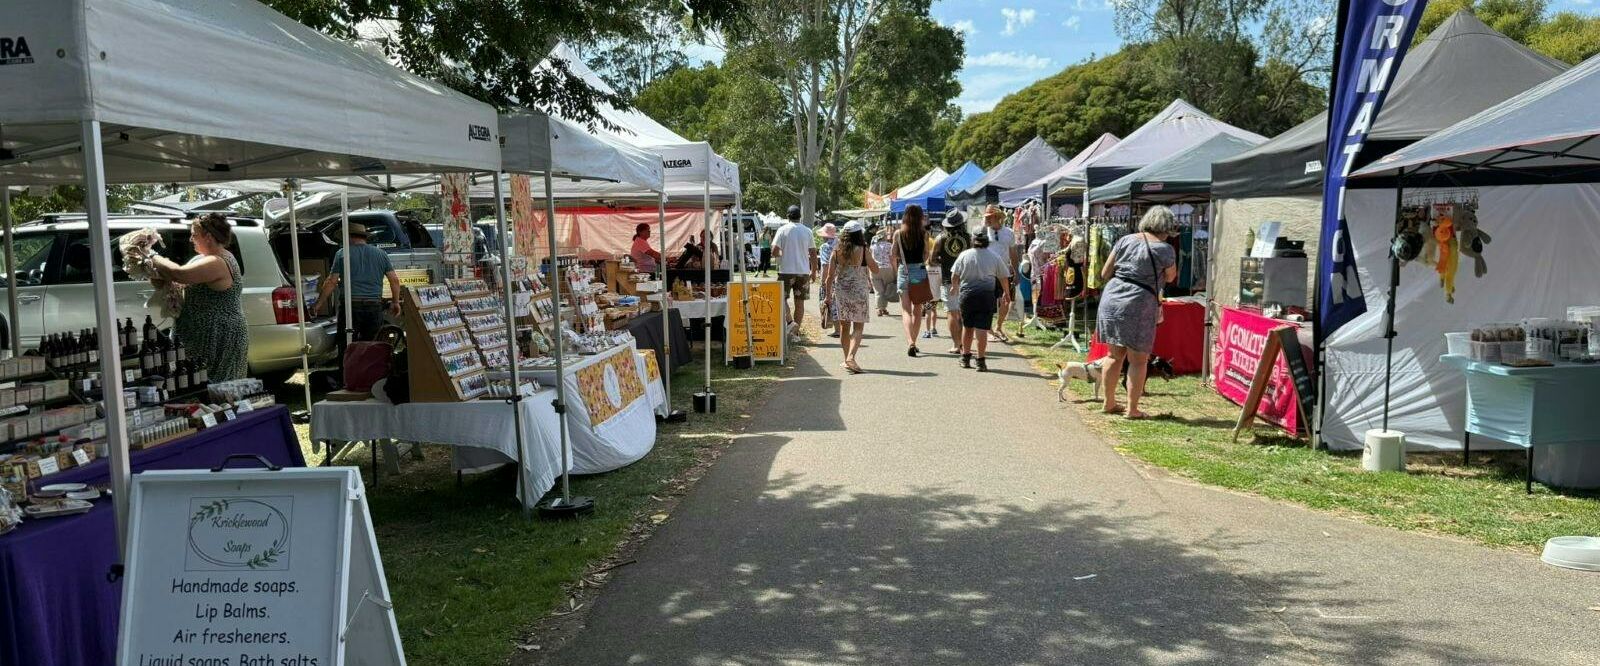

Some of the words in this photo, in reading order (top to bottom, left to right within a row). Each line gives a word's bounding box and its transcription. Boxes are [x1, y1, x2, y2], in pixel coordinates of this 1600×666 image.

[738, 301, 773, 314] HVES
[1230, 324, 1268, 355] GOMATH
[211, 512, 272, 529] Kricklewood
[223, 539, 252, 559] Soaps
[171, 578, 249, 593] Handmade
[253, 580, 300, 597] soaps.
[195, 603, 218, 623] Lip
[223, 603, 271, 618] Balms.
[173, 629, 197, 644] Air
[202, 628, 291, 644] fresheners.
[239, 654, 274, 666] Bath
